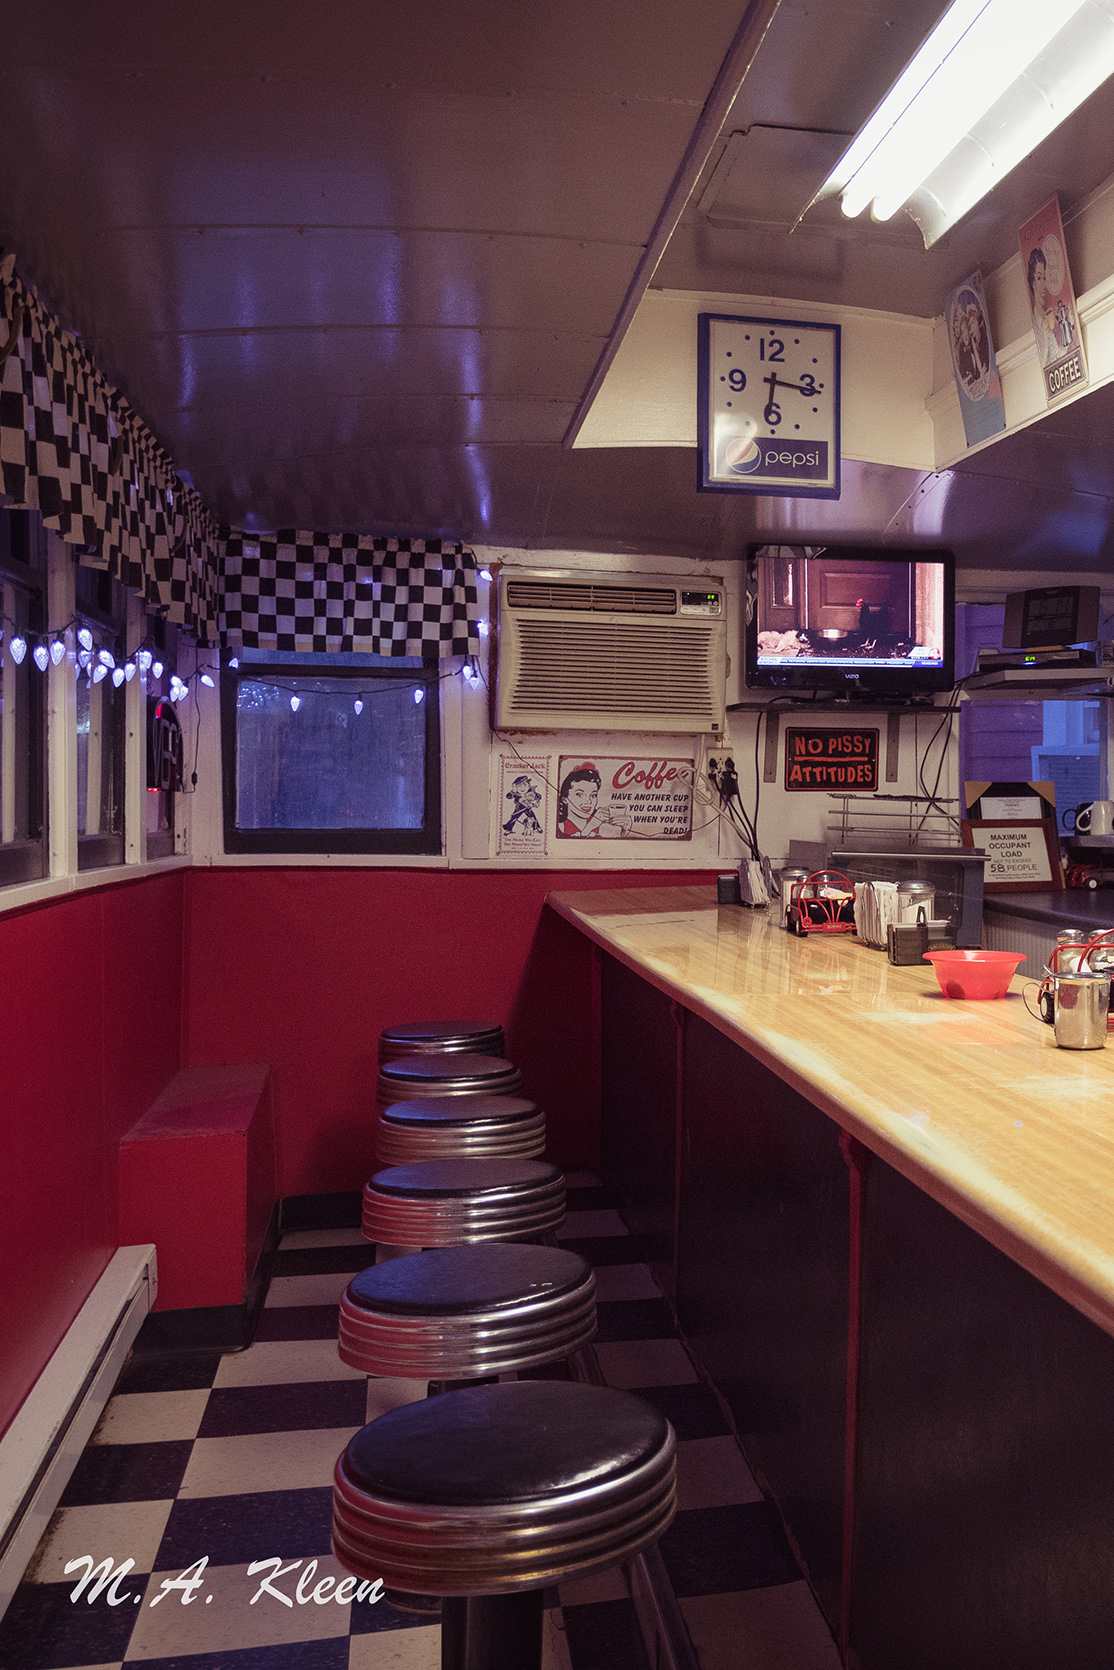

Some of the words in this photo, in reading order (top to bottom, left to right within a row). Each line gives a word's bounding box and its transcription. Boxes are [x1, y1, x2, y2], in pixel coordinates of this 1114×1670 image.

[760, 338, 785, 362] 12
[728, 368, 747, 392] 9
[1049, 356, 1081, 393] COFFEE
[799, 374, 816, 397] 3
[763, 402, 782, 426] 6
[765, 451, 819, 468] pepsi
[795, 737, 823, 755] NO
[828, 735, 871, 754] PISSY
[790, 765, 872, 782] ATTITUDES
[634, 794, 671, 802] ANOTHER
[664, 805, 688, 813] SLEEP
[660, 816, 688, 824] YOU'RE
